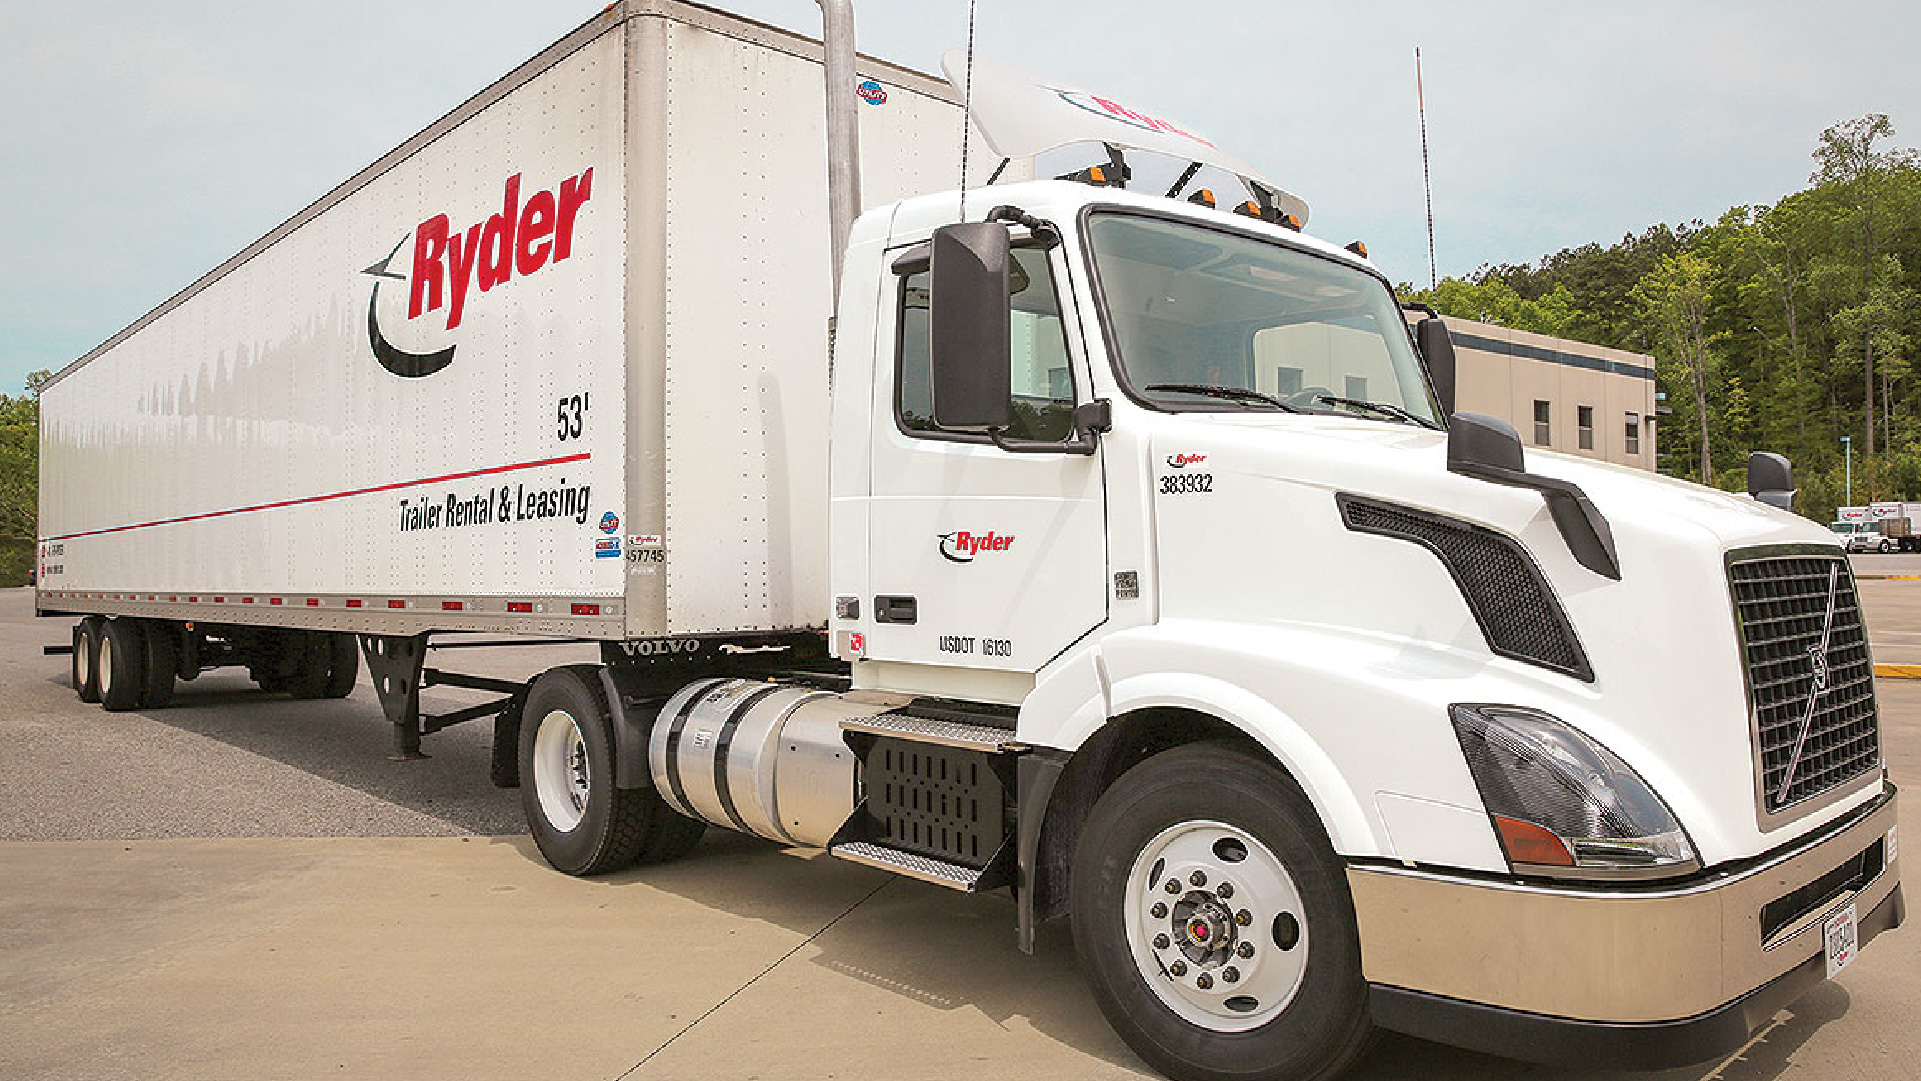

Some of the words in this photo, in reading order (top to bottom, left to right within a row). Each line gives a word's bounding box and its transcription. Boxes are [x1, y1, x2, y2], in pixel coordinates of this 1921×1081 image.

[408, 167, 593, 330] Ryder
[557, 392, 589, 441] 53'
[1175, 454, 1207, 466] Ryder
[1160, 474, 1212, 494] 383932
[400, 497, 442, 532] Trailer
[446, 488, 495, 528] Rental
[499, 485, 511, 523] &
[516, 478, 590, 525] Leasing
[956, 531, 1015, 555] Ryder
[618, 639, 701, 656] VOLVO
[939, 636, 976, 653] USDOT
[982, 639, 1012, 656] 16130
